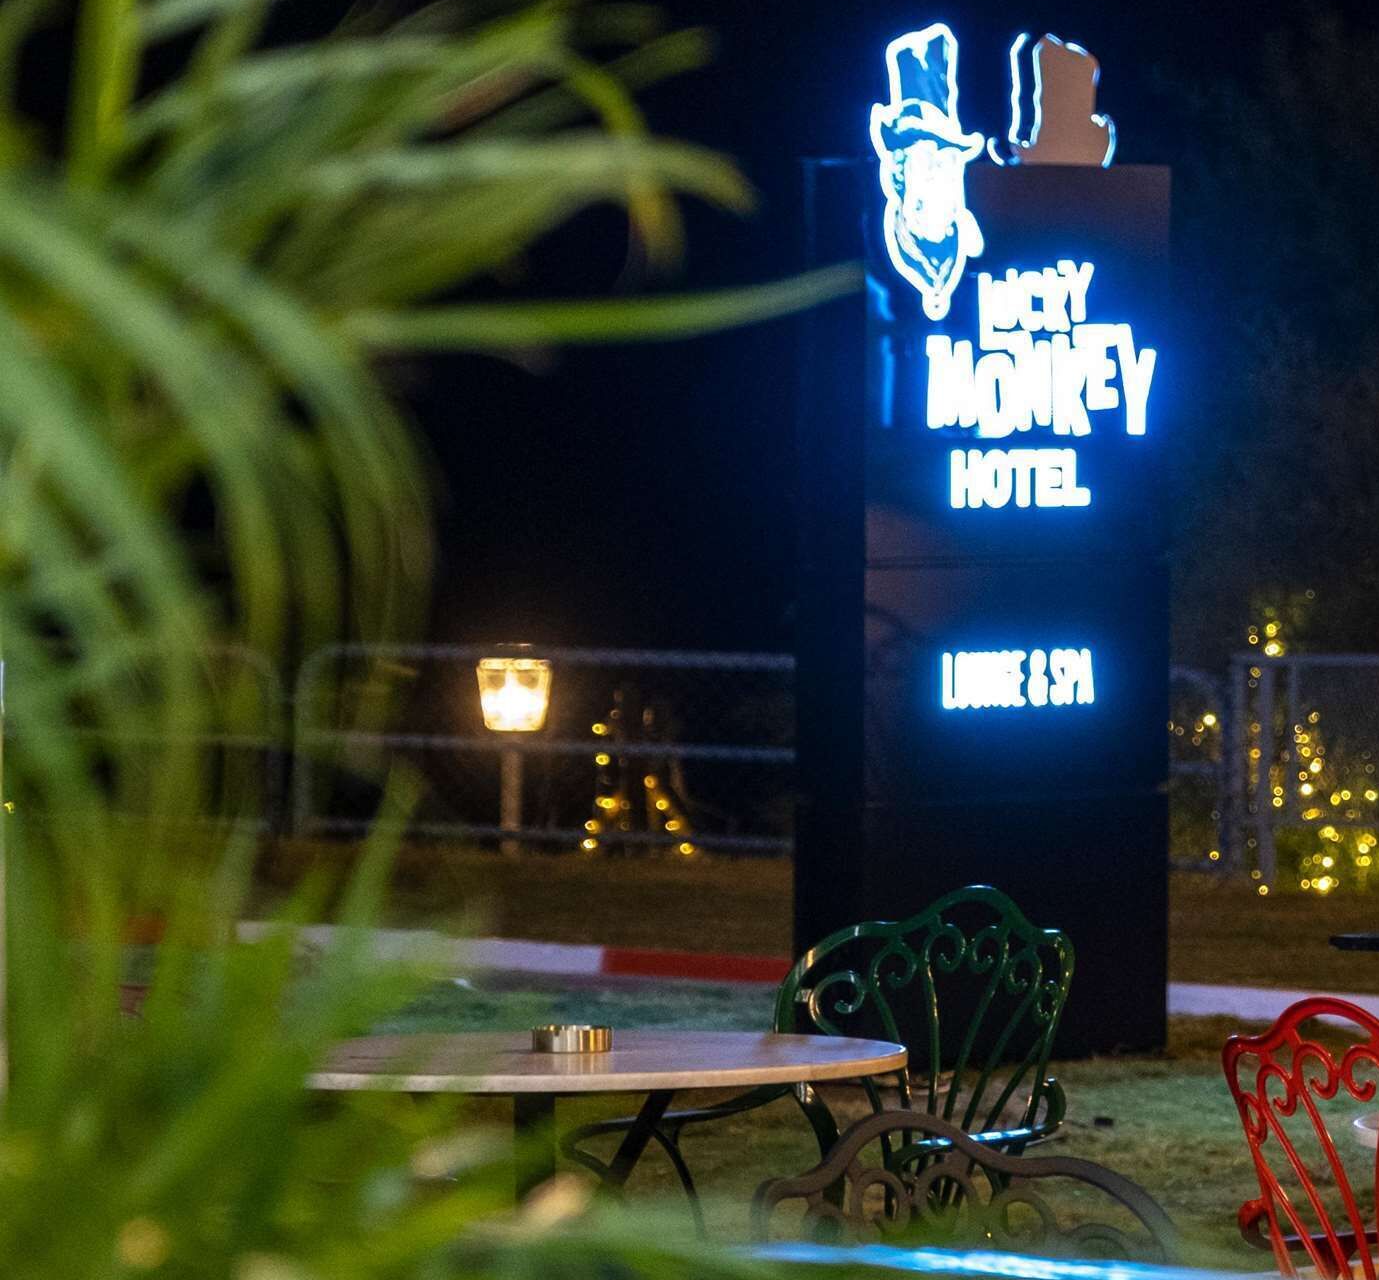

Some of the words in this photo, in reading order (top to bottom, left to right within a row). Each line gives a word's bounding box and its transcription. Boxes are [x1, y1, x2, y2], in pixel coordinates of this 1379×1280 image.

[978, 260, 1094, 350] LUCKY
[925, 323, 1156, 438] MONKEY
[949, 448, 1091, 509] HOTEL
[1049, 648, 1095, 705] SPA
